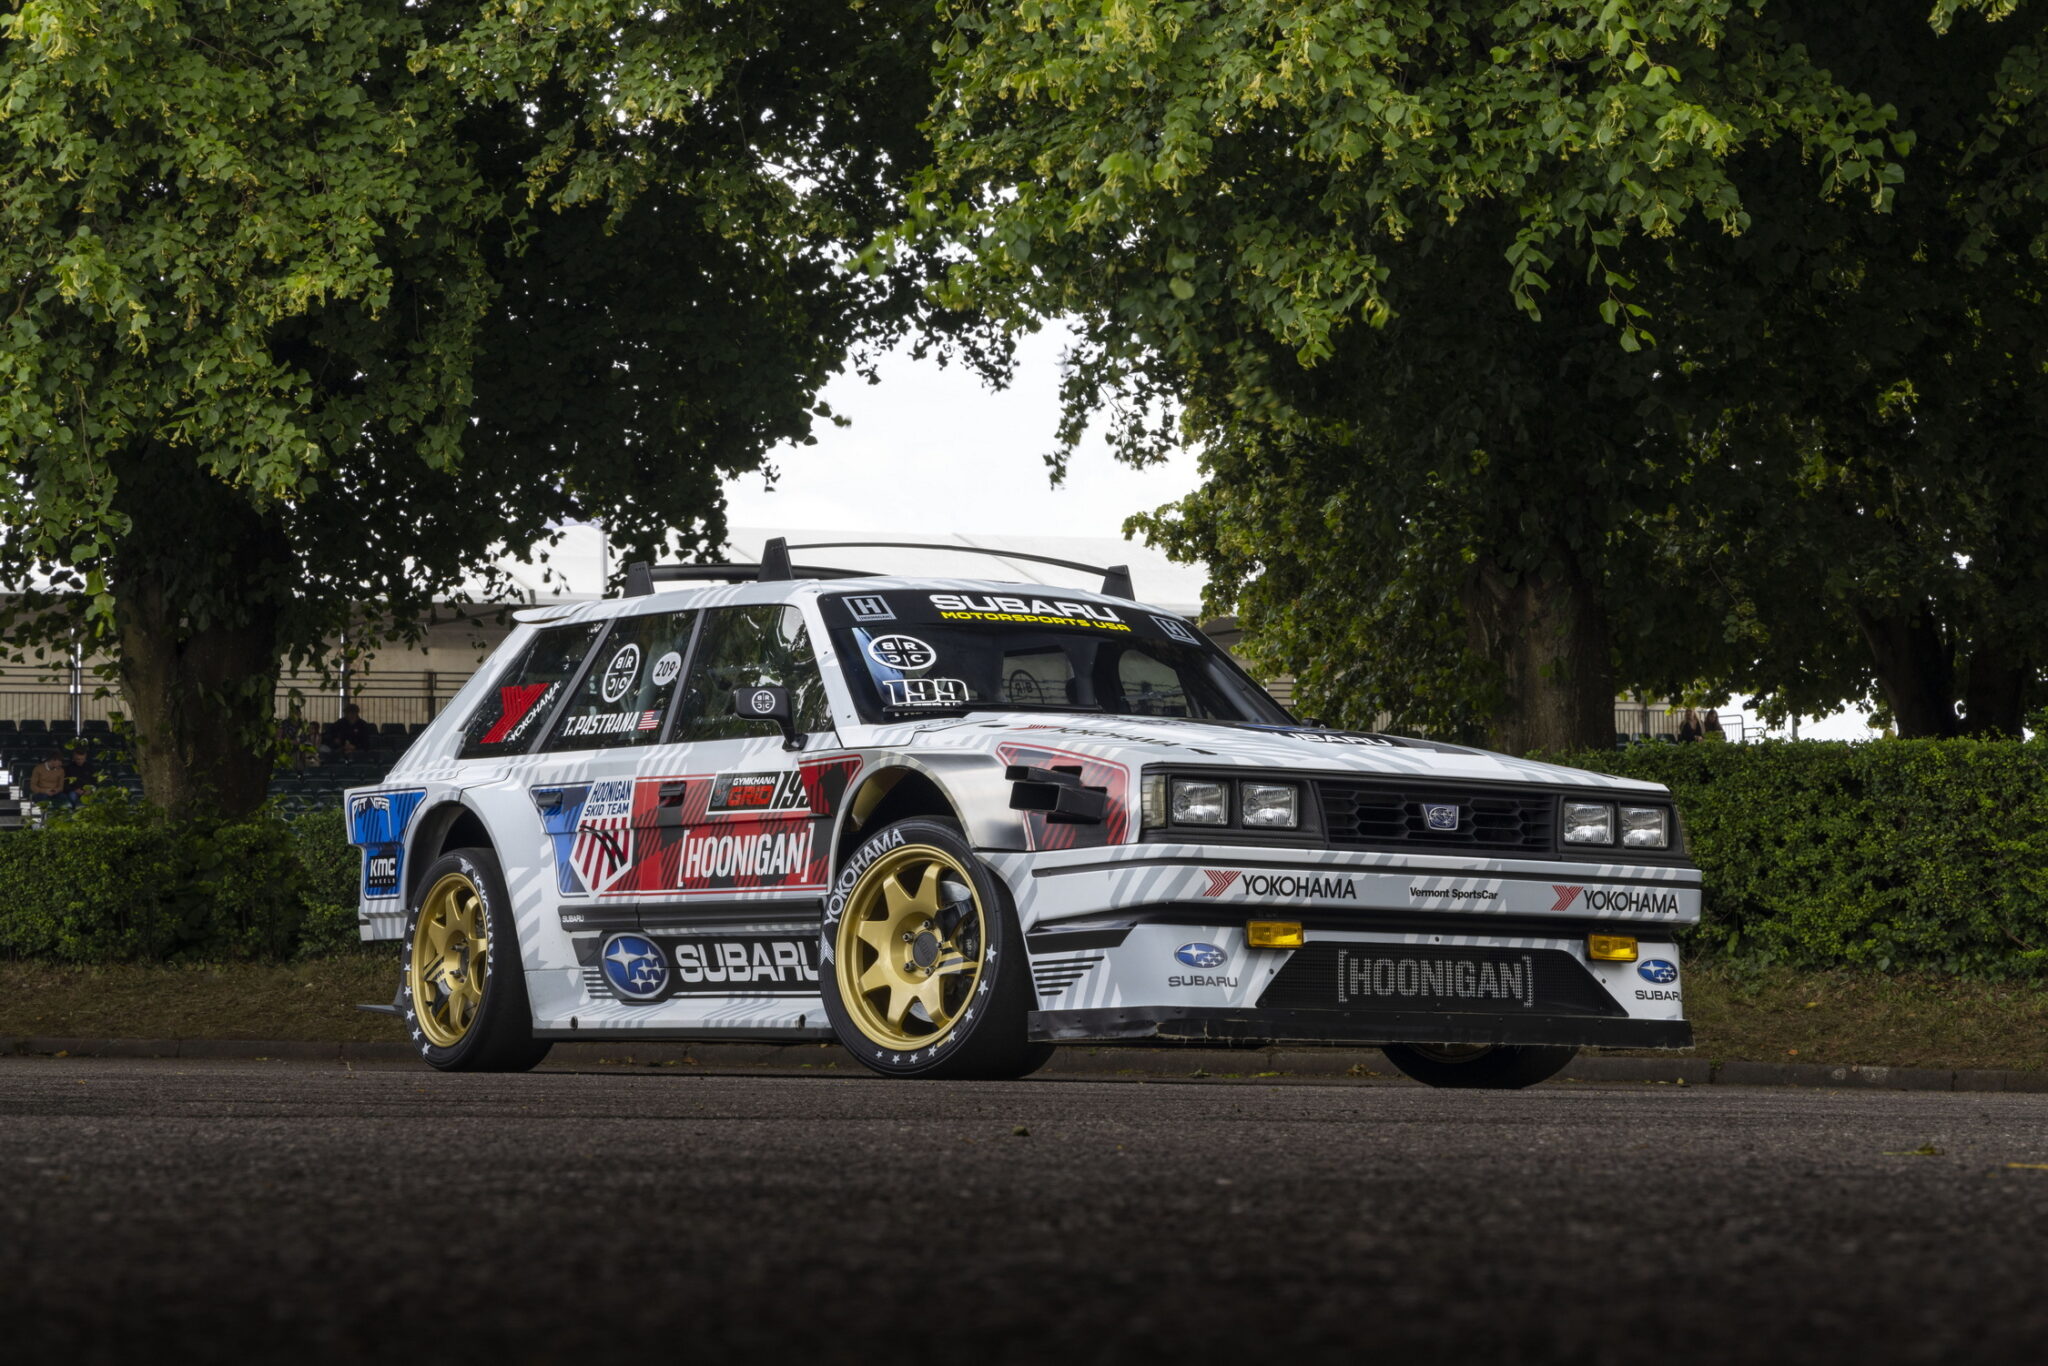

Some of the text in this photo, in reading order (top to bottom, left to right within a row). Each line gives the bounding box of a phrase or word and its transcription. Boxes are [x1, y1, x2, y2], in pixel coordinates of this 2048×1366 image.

[930, 594, 1124, 623] SUBARU
[941, 611, 1132, 632] MOTORSPORTS USA
[655, 660, 677, 677] 209
[507, 681, 561, 743] YOKOHAMA
[589, 780, 633, 803] HOONIGAN
[732, 776, 776, 786] GYMKHANA
[726, 785, 774, 807] GRID
[584, 802, 630, 817] SKID TEAM
[369, 858, 396, 877] KMC
[824, 828, 906, 925] YOKOHAMA
[1242, 873, 1357, 900] YOKOHAMA
[1409, 886, 1499, 901] Vermont SportsCar
[1583, 889, 1680, 914] YOKOHAMA
[675, 942, 820, 983] SUBARU
[1168, 974, 1239, 988] SUBARU
[1634, 989, 1682, 1001] SUBAR
